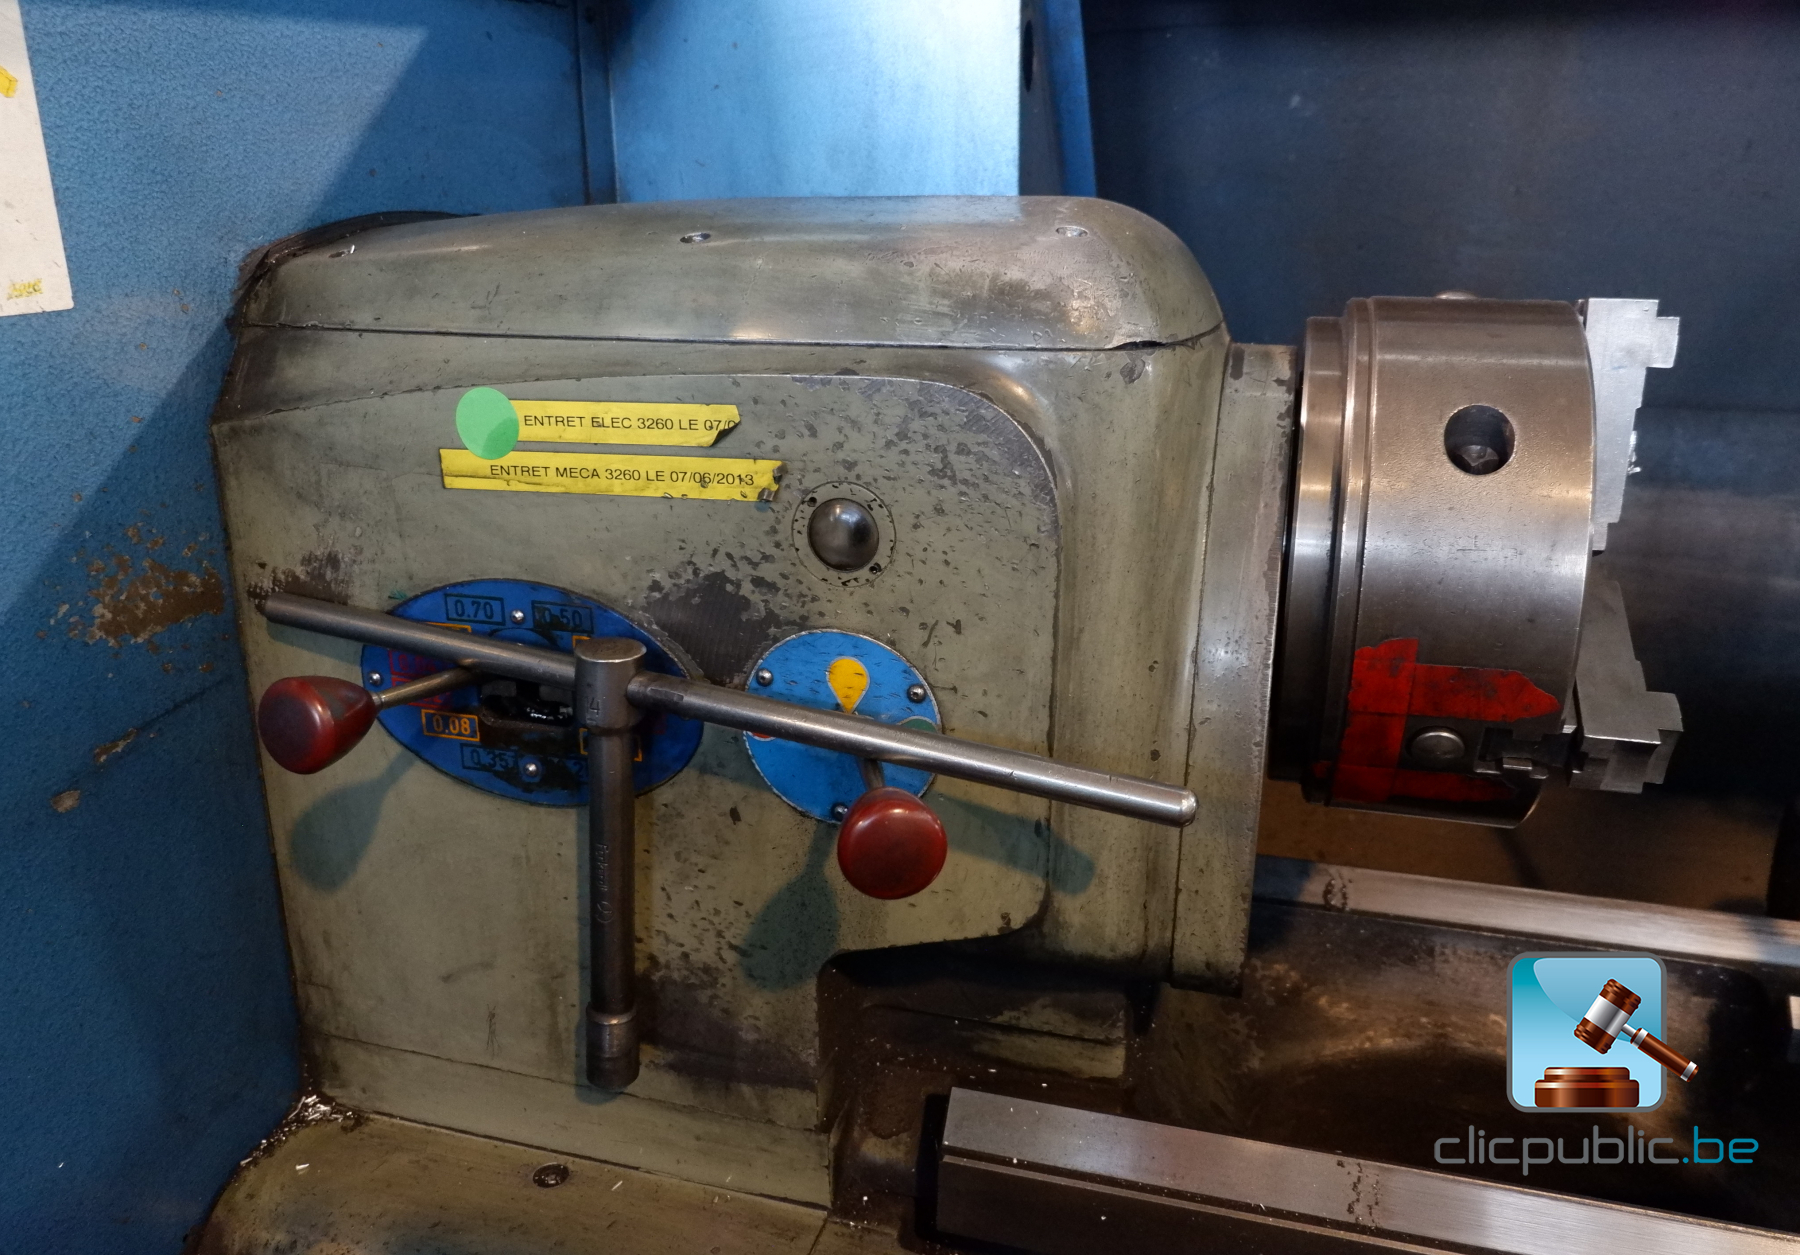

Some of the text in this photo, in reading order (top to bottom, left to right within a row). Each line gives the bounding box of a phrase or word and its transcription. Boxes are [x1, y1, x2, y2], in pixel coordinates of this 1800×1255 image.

[524, 415, 586, 429] ENTRET
[591, 416, 633, 430] ELEC
[637, 418, 674, 431] 3260
[679, 418, 700, 431] LE
[490, 464, 755, 486] ENTRET MECA 3260 LE 07/06/2013
[454, 599, 494, 620] 0.70
[542, 607, 583, 628] 050
[432, 714, 471, 735] 0.08
